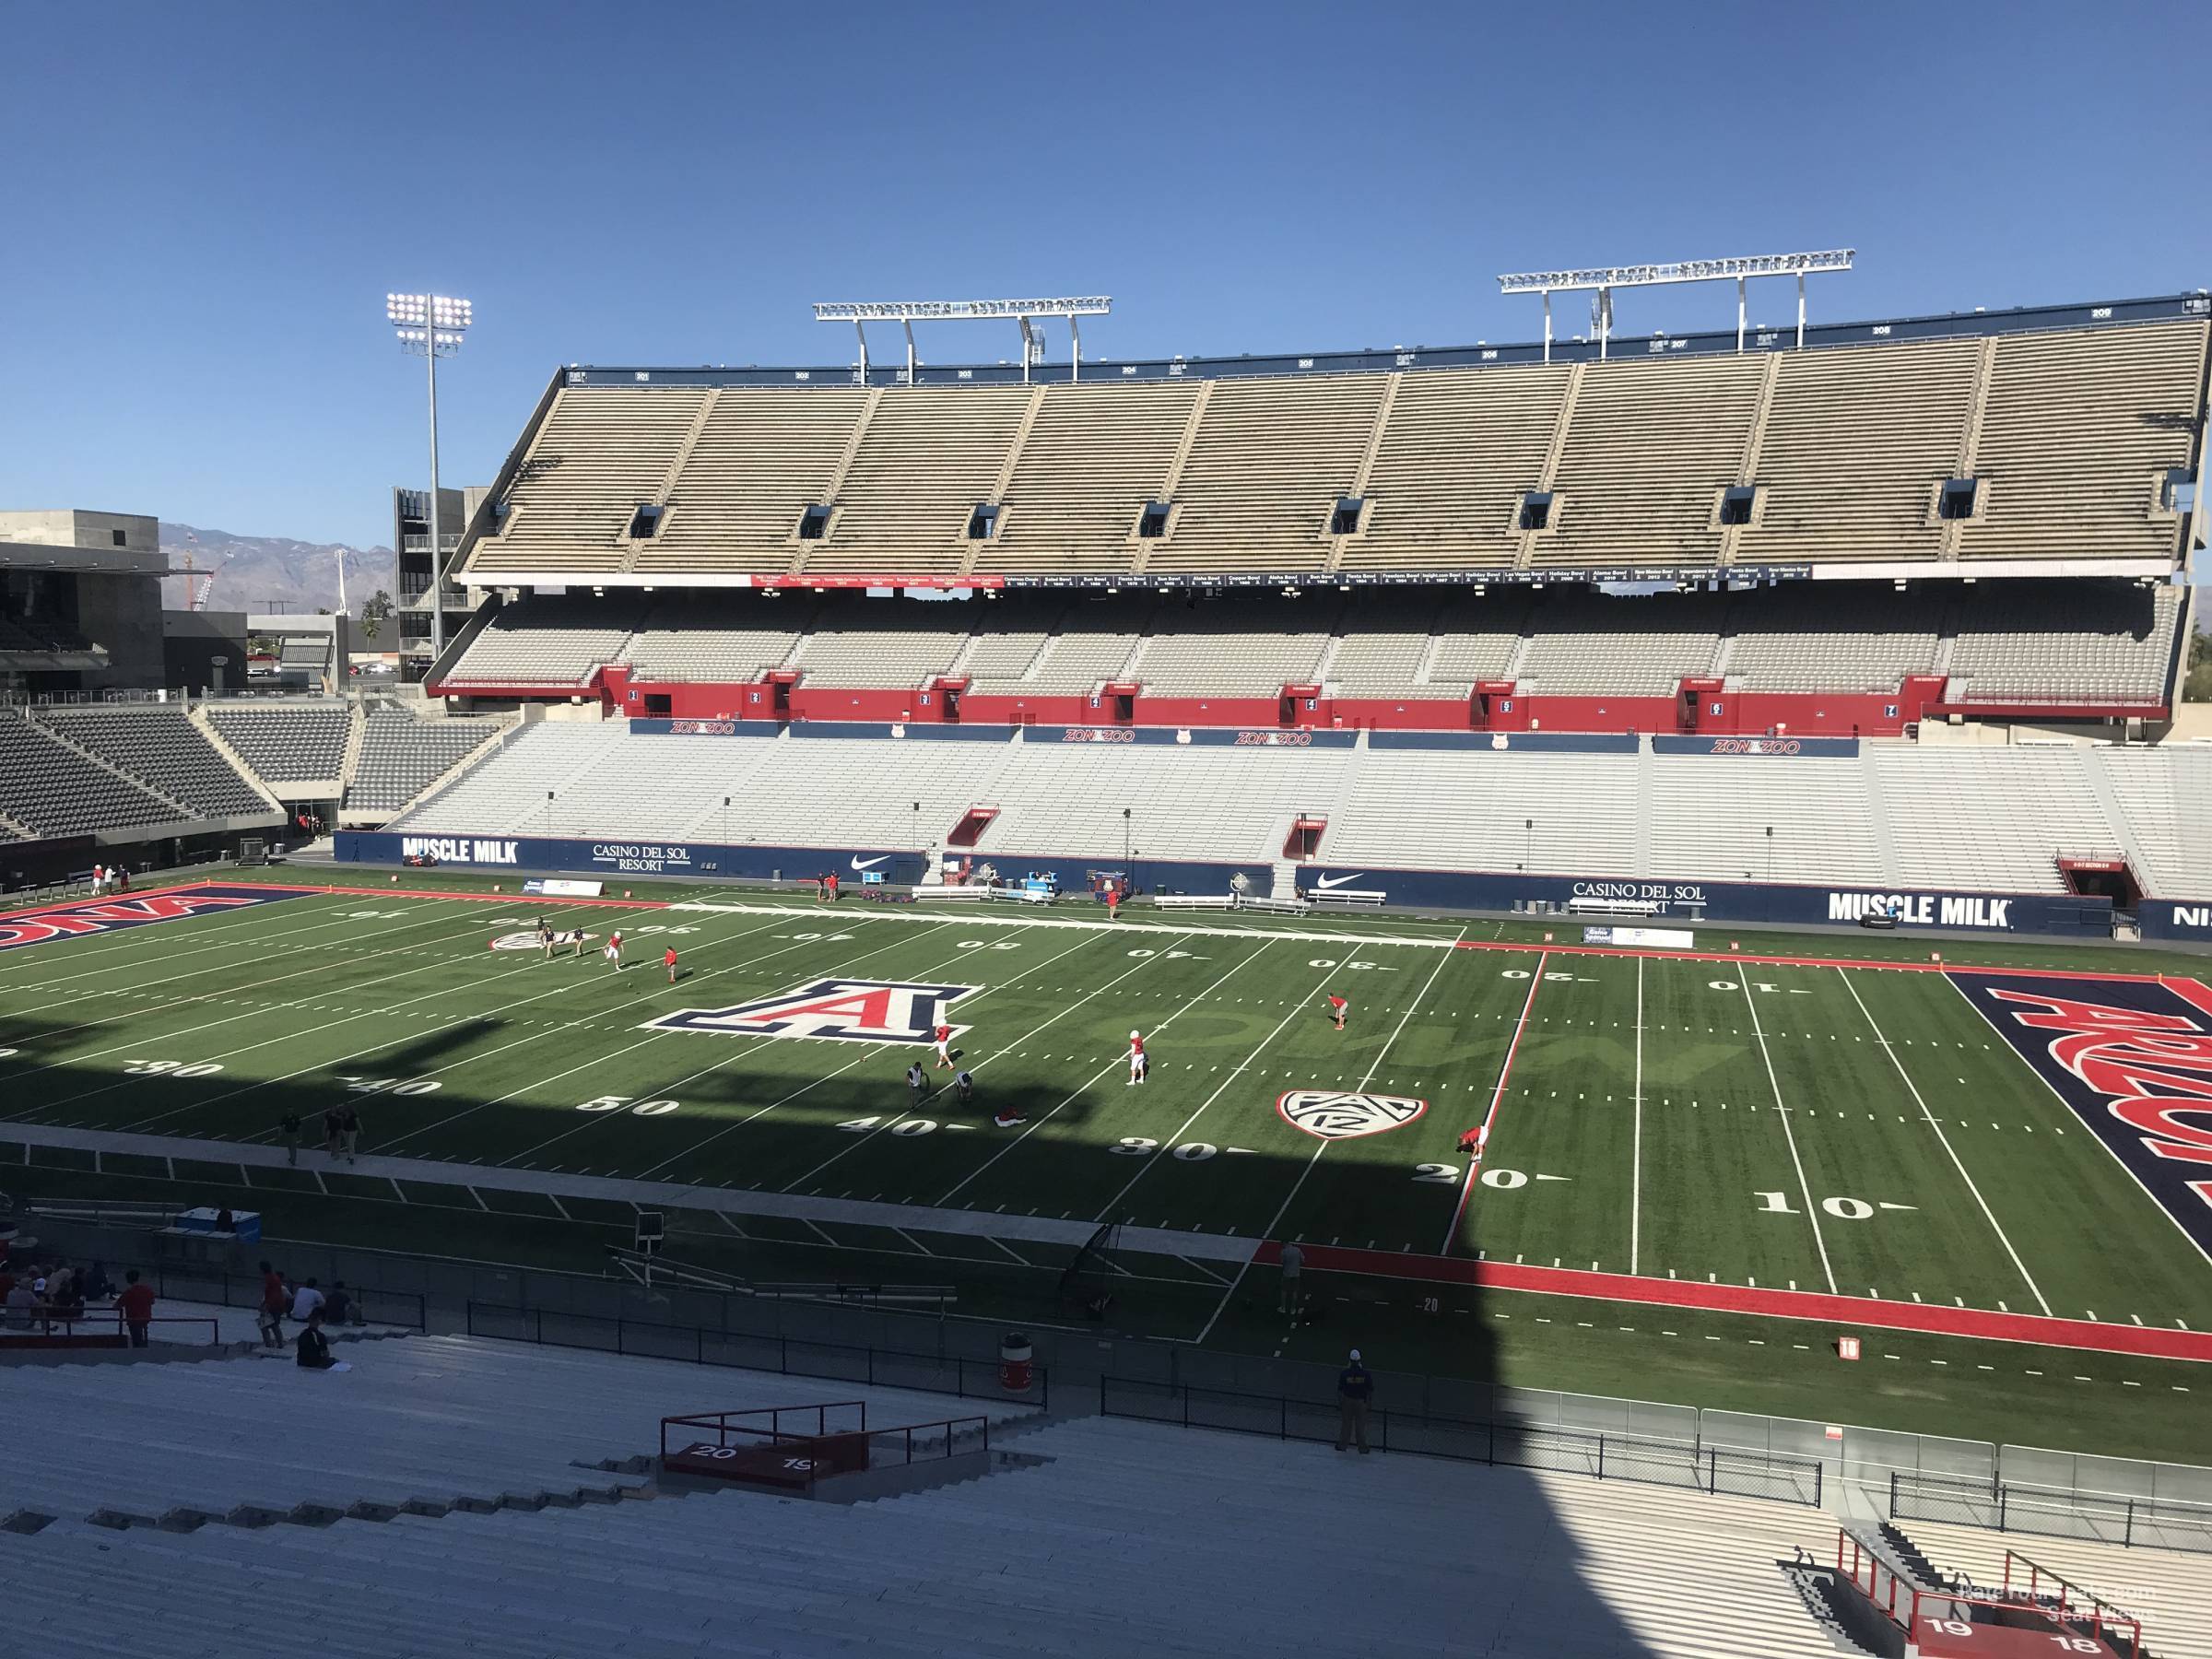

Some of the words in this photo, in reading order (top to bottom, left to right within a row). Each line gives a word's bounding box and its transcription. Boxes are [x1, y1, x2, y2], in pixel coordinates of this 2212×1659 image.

[402, 838, 470, 862] MUSCLE
[474, 841, 518, 864] MILK
[593, 845, 640, 857] CASINO
[642, 846, 665, 858] DEL
[666, 848, 689, 860] SOL
[619, 858, 664, 871] RESORT
[1573, 882, 1636, 897] CASINO
[1641, 885, 1671, 900] DEL
[1674, 886, 1705, 900] SOL
[1829, 893, 1935, 924] MUSCLE
[1940, 897, 2009, 927] MILK
[2173, 907, 2212, 926] NI
[124, 1061, 225, 1077] 30
[347, 1078, 442, 1096] 40
[575, 1095, 680, 1115] 50
[835, 1116, 937, 1136] 40
[1108, 1137, 1218, 1161] 30
[1411, 1163, 1528, 1189] 20
[1753, 1191, 1874, 1219] 10
[1423, 1297, 1438, 1312] 20
[1841, 1339, 1858, 1358] 10
[691, 1445, 737, 1459] 20
[782, 1458, 818, 1470] 19
[1924, 1617, 1973, 1637] 19
[2050, 1636, 2102, 1654] 18
